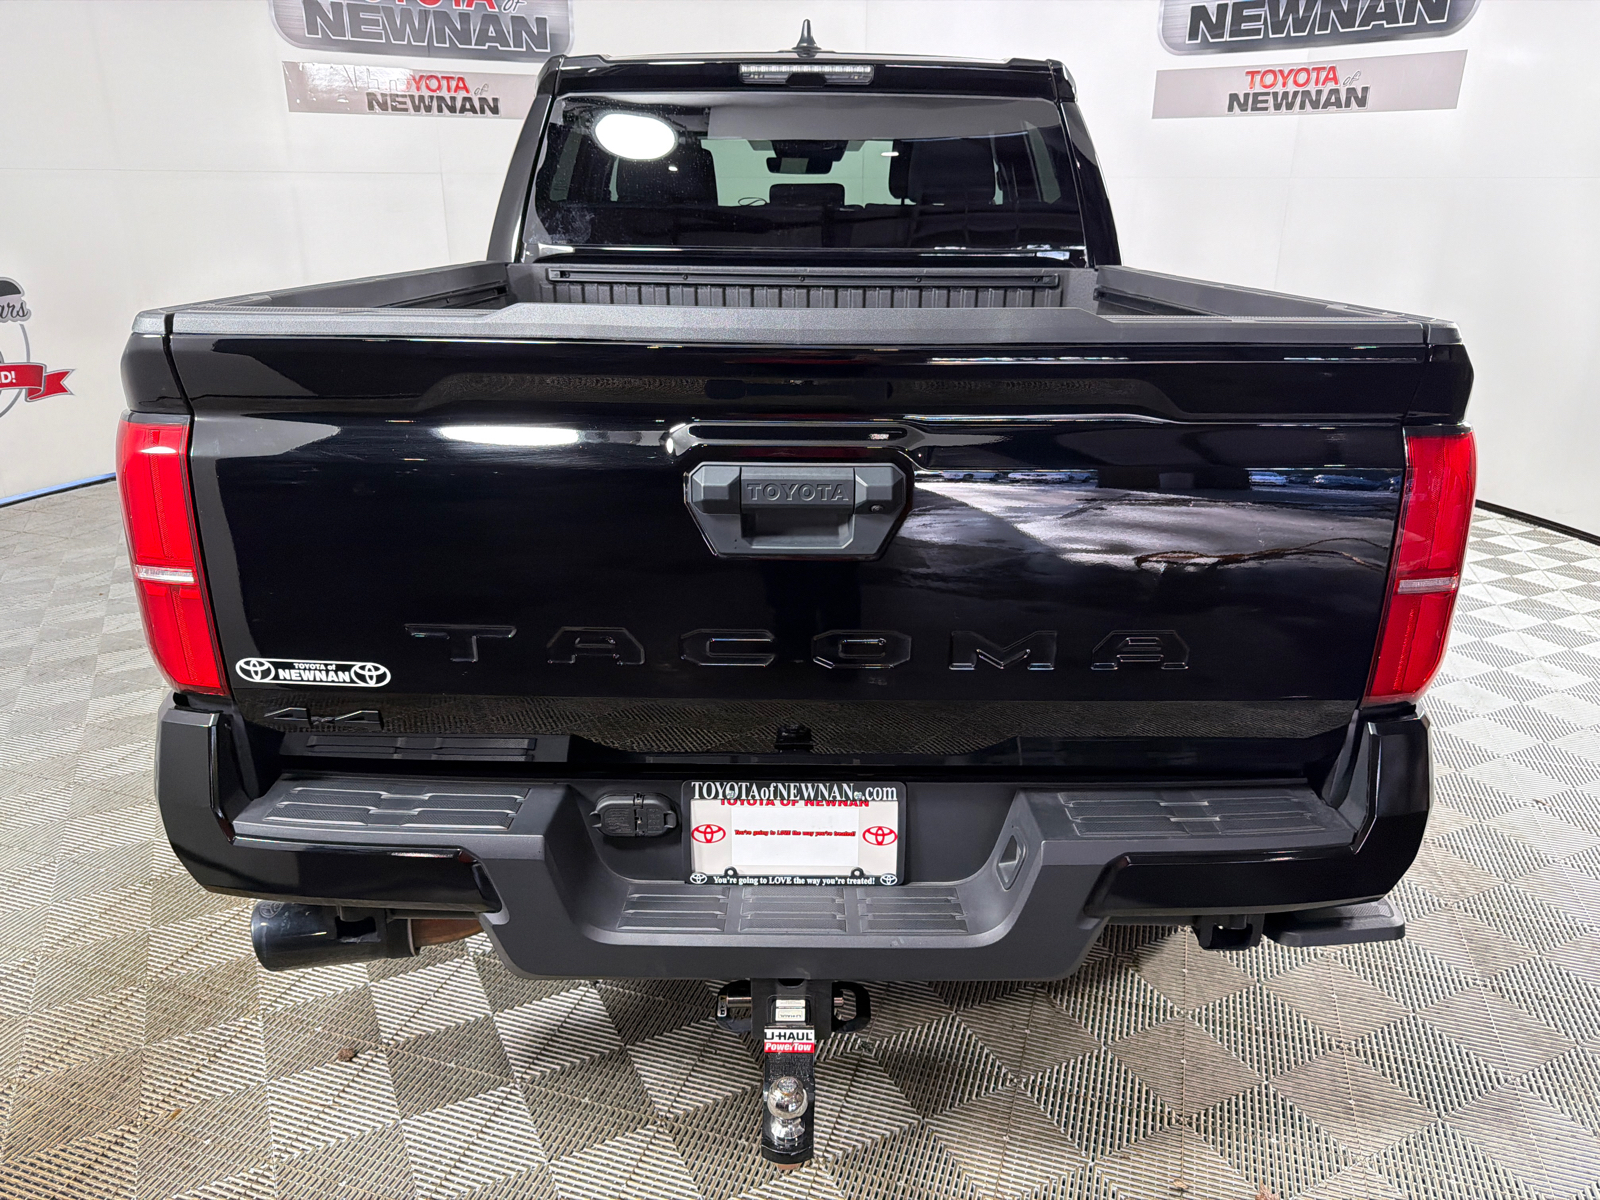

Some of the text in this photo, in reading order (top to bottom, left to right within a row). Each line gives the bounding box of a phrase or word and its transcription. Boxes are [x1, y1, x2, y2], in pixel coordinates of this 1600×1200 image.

[304, 1, 551, 51] NEWNAN
[1186, 0, 1451, 43] NEWNAN
[396, 73, 489, 96] YOTA of
[1245, 65, 1361, 90] TOYOTA of
[366, 92, 499, 115] NEWNAN
[1227, 86, 1369, 113] NEWNAN
[0, 371, 16, 383] D!
[747, 483, 849, 501] TOYOTA
[404, 624, 1190, 671] TACOMA
[278, 668, 351, 682] NEWNAN
[293, 662, 337, 671] TOYOTA of
[713, 876, 876, 887] You're going to LOVE the way you're treated!
